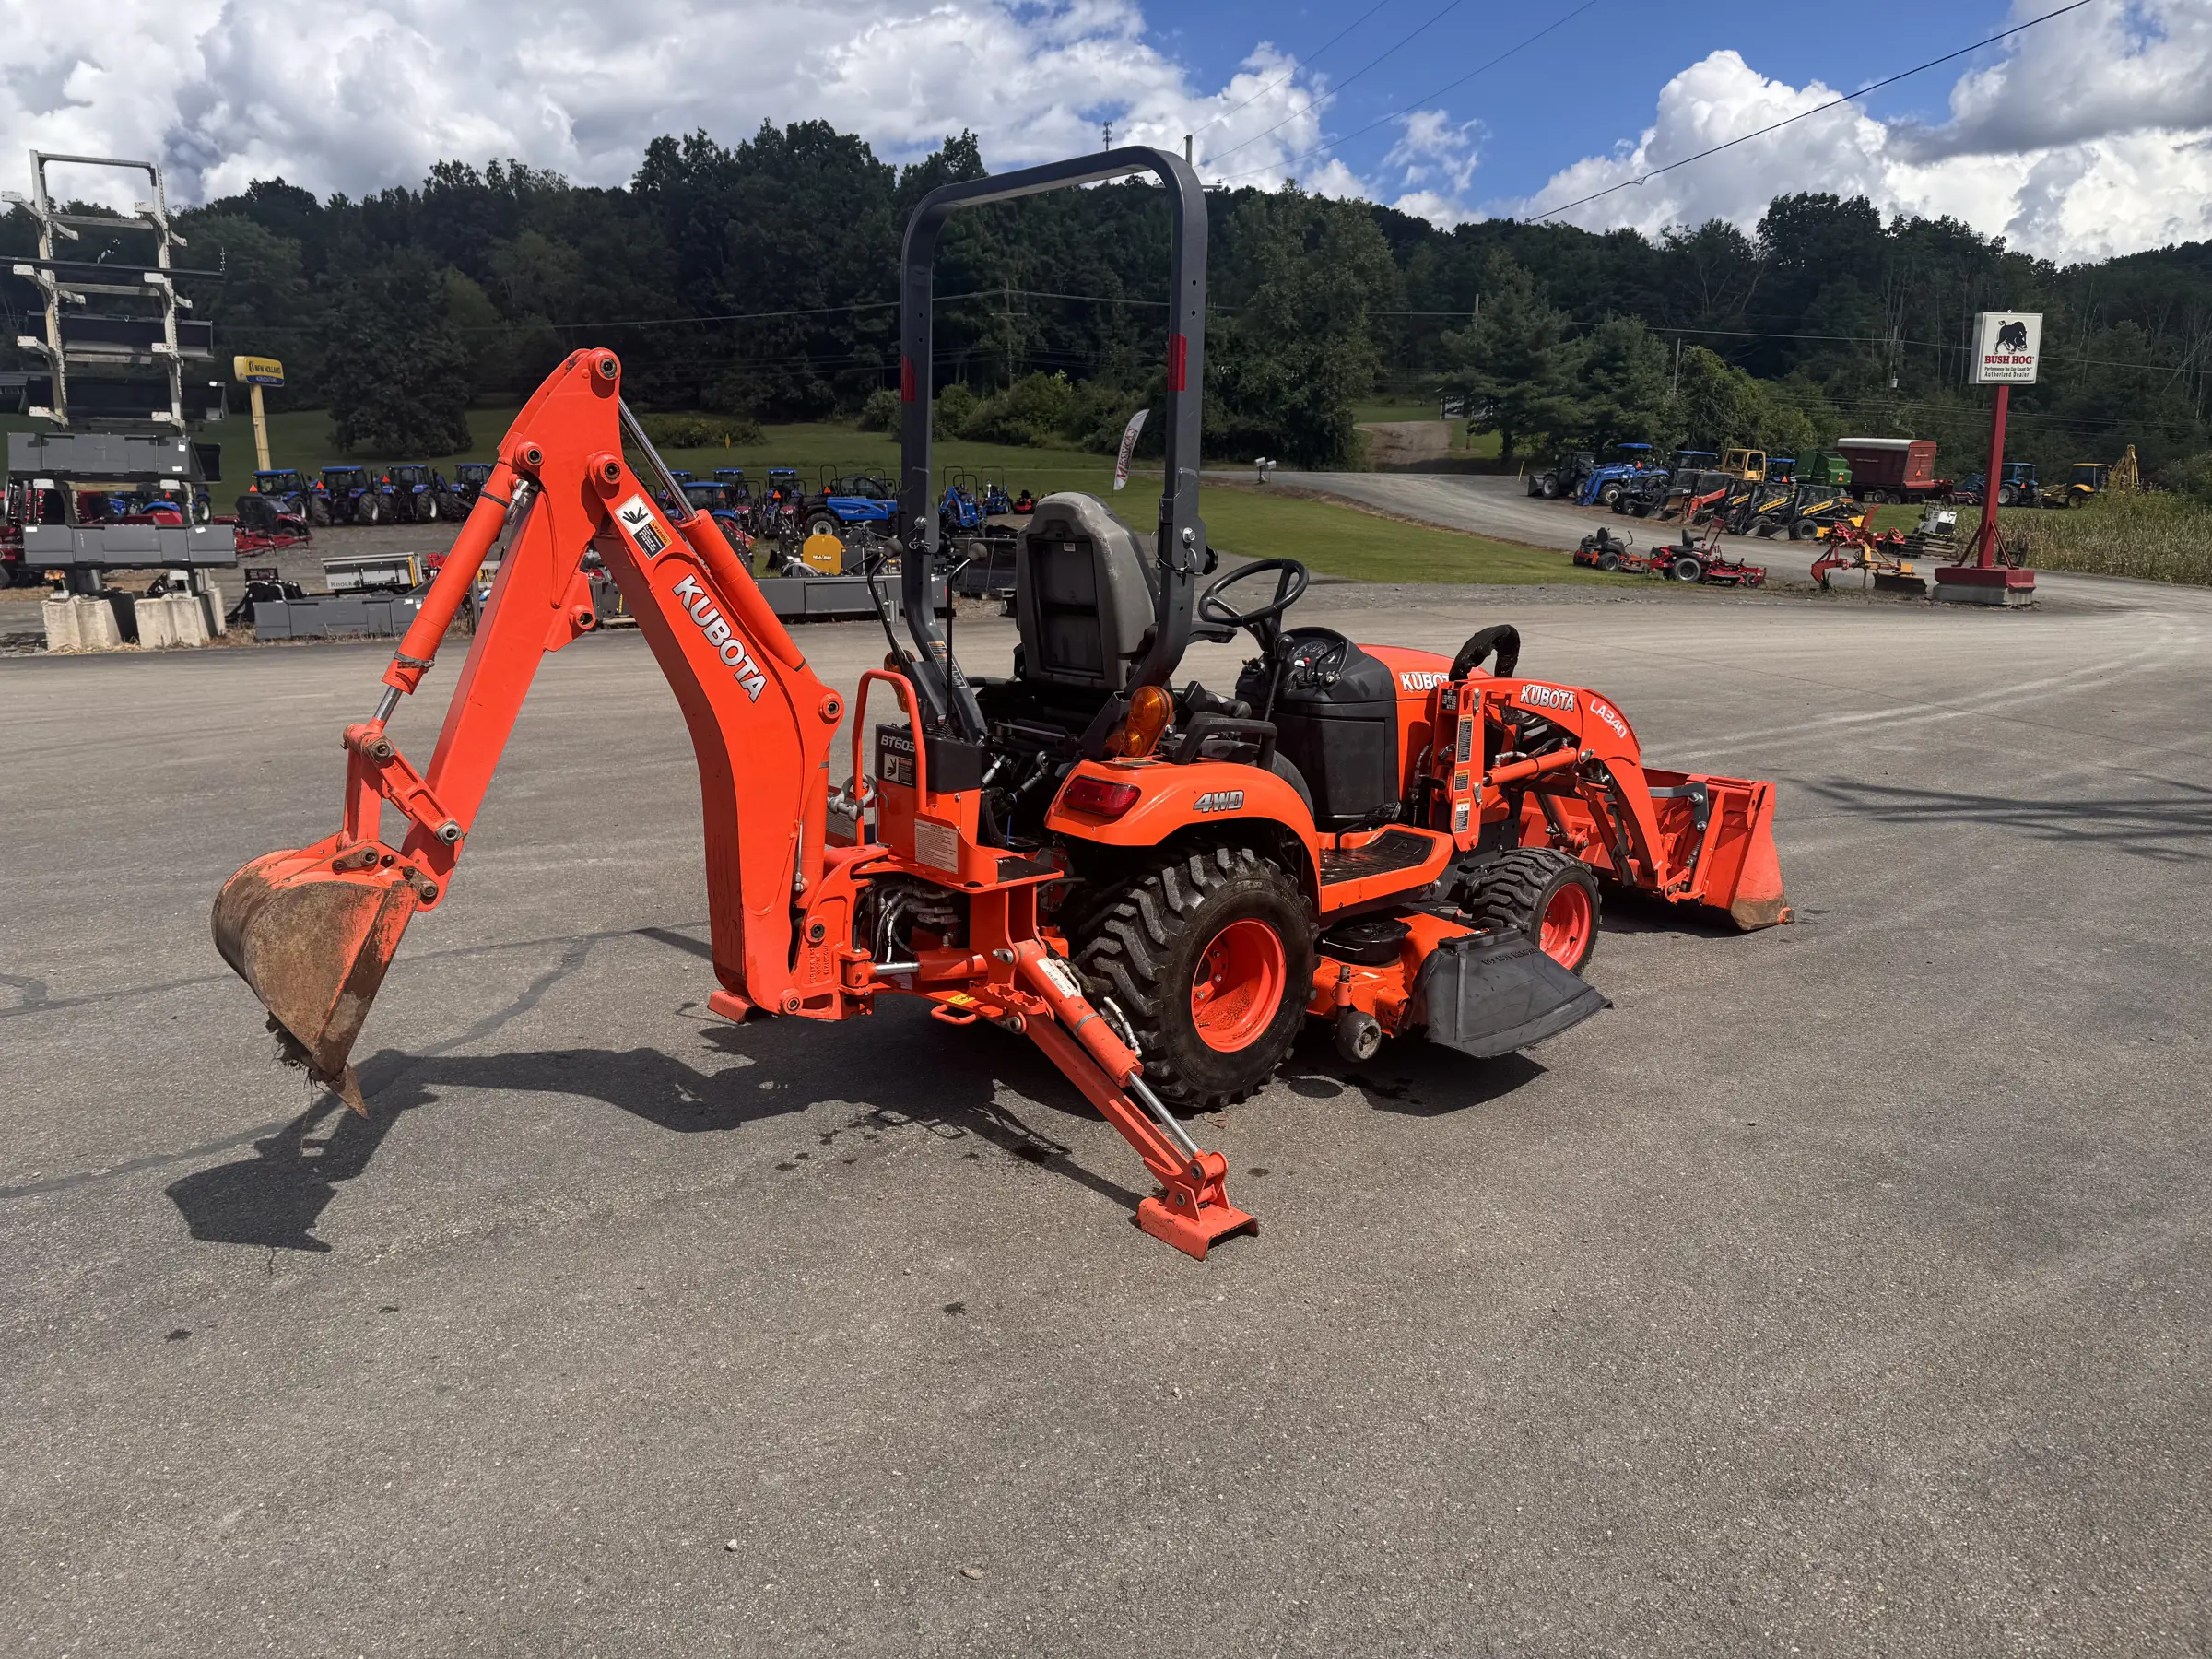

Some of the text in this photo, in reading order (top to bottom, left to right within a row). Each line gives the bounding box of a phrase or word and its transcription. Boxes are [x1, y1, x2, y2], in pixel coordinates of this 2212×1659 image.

[265, 366, 281, 374] HOLLAND
[1983, 355, 2032, 364] BUSH HOG
[672, 573, 768, 704] KUBOTA
[1399, 672, 1450, 691] KUBOT
[1520, 684, 1575, 712] KUBOTA
[1589, 699, 1628, 738] LA340
[880, 735, 916, 752] BT603
[1193, 789, 1245, 813] 4WD
